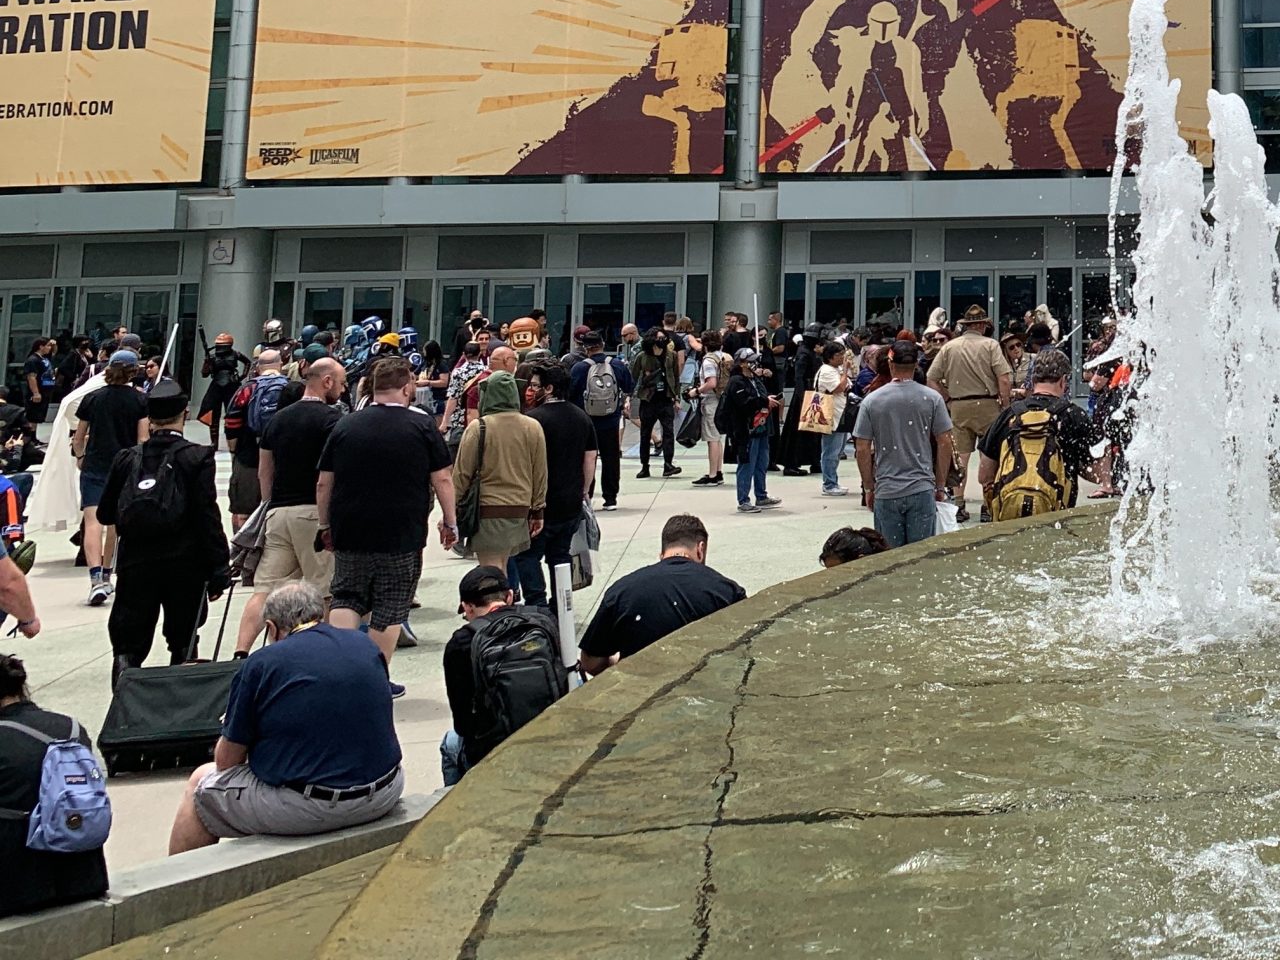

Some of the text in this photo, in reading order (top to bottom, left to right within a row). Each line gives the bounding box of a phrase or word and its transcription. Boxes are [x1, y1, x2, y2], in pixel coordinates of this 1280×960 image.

[259, 148, 292, 157] REED
[309, 148, 360, 165] LUCASFILM
[262, 157, 289, 166] POP
